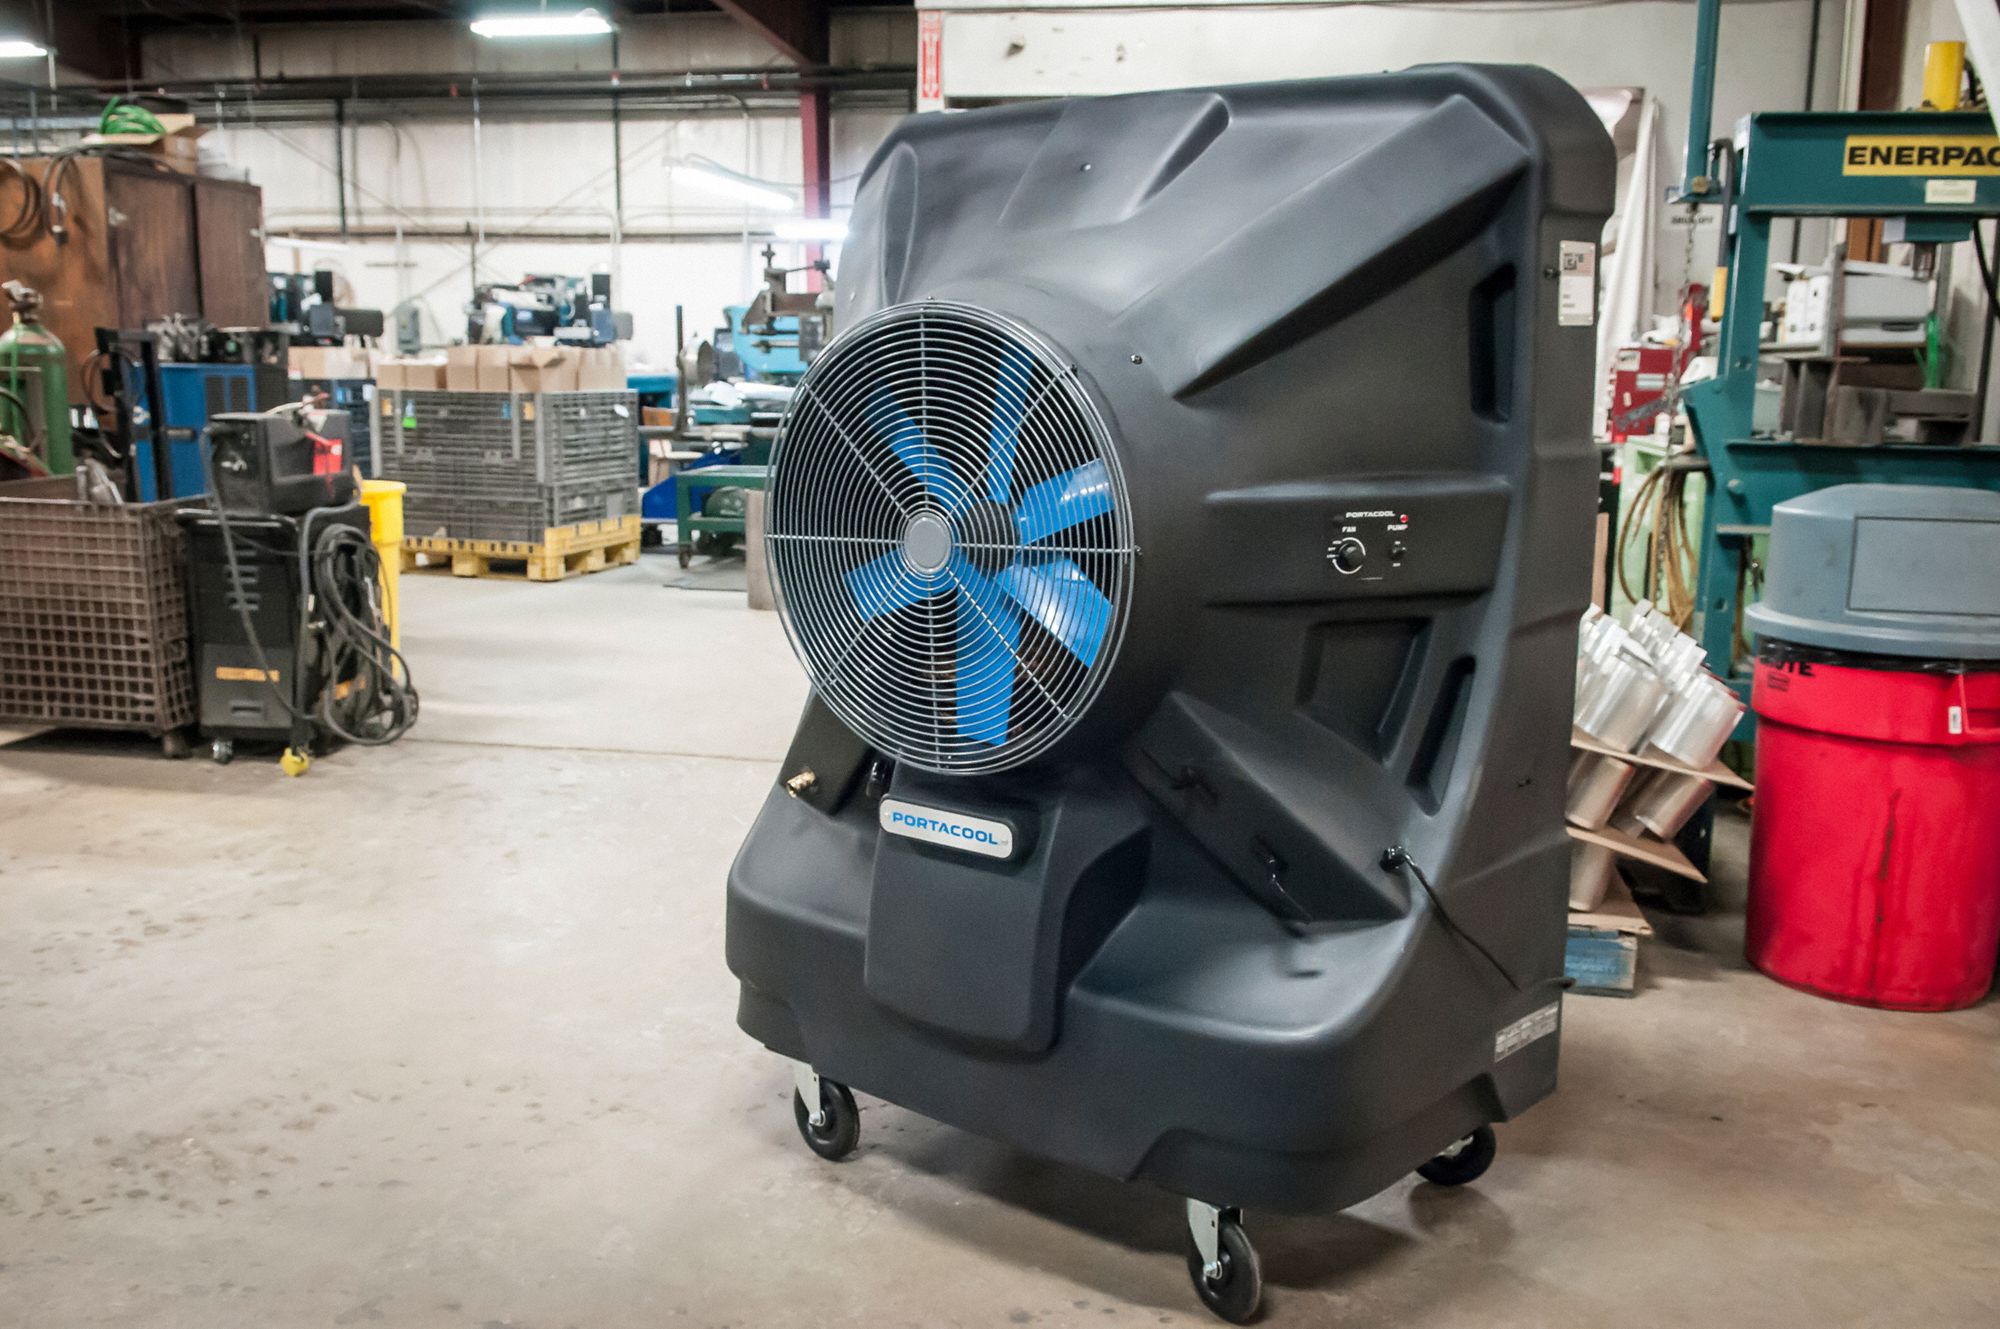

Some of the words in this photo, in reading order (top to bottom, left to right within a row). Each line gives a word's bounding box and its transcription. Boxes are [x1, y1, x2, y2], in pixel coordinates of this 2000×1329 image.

[1848, 145, 2000, 166] ENERPAC
[1345, 510, 1396, 519] PORTACOOL
[1341, 525, 1357, 533] FAN
[1387, 524, 1408, 532] PUMP
[892, 811, 999, 845] PORTACOOL
